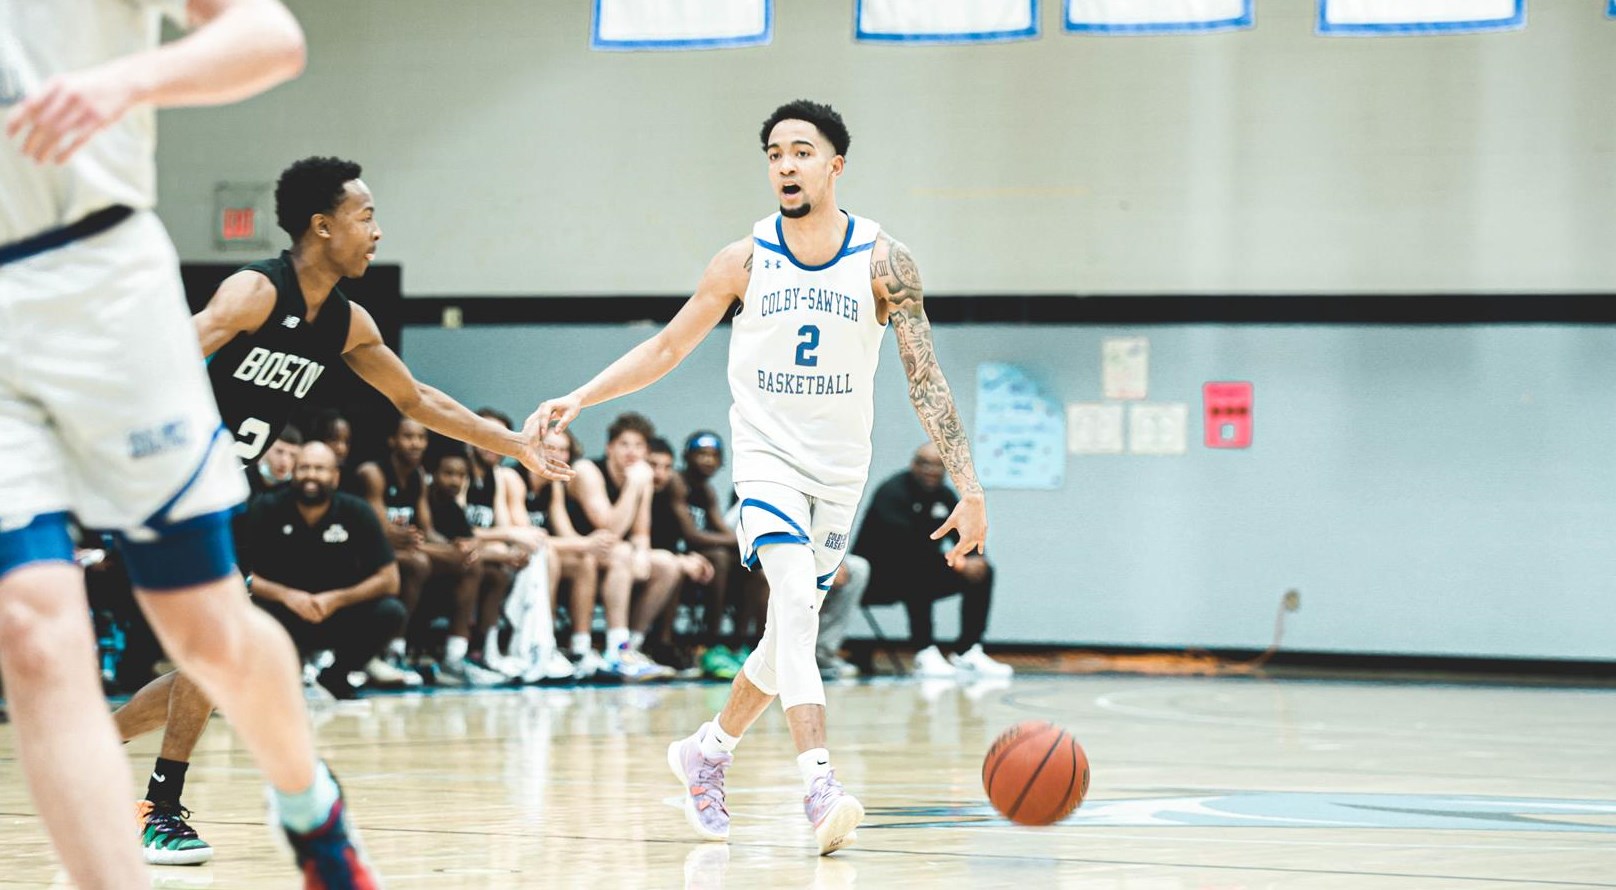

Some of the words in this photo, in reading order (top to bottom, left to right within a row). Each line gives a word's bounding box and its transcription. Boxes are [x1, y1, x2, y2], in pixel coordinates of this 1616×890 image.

[761, 287, 858, 322] COLBY-SAWYER
[795, 325, 820, 367] 2
[758, 369, 853, 395] BASKETBALL
